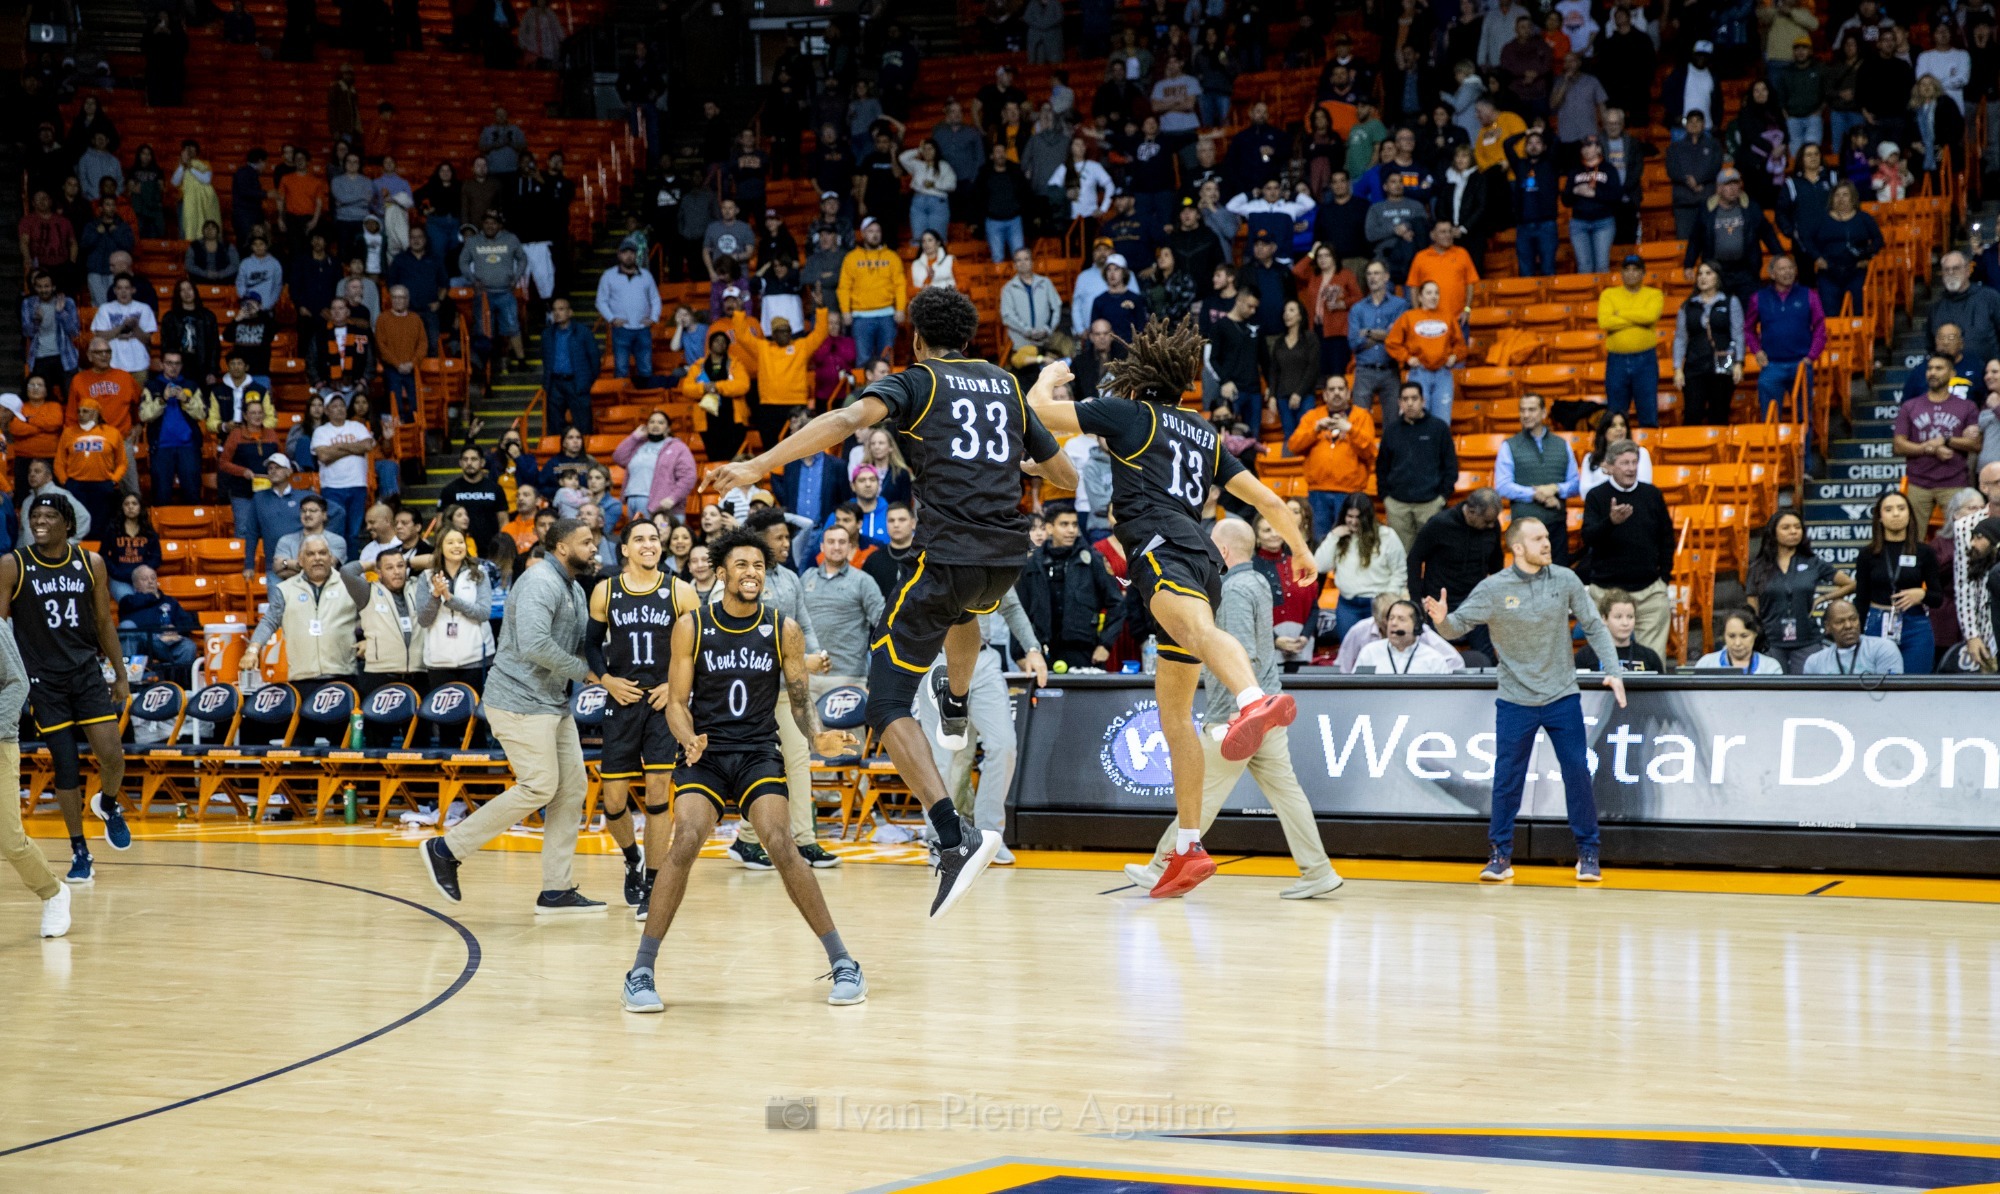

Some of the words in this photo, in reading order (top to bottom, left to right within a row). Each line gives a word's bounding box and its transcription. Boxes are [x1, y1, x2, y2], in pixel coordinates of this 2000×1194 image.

[41, 24, 54, 42] D
[89, 381, 121, 398] UTEP
[945, 374, 1011, 396] THOMAS
[1913, 412, 1931, 430] NM
[1933, 411, 1961, 430] STATE
[950, 398, 1010, 463] 33
[1163, 412, 1215, 451] SULLINGER
[1860, 443, 1893, 459] THE
[1167, 439, 1203, 507] 13
[455, 492, 496, 502] ROGUE
[1819, 485, 1841, 499] OF
[1843, 484, 1882, 498] UTEP
[116, 536, 148, 548] UTEP
[1807, 525, 1852, 540] WE'RE
[1837, 548, 1860, 563] UP
[32, 578, 58, 596] Kent
[59, 575, 86, 594] State
[45, 598, 79, 629] 34
[612, 608, 639, 627] Kent
[641, 604, 671, 627] State
[207, 638, 221, 654] G
[629, 631, 655, 665] 11
[704, 649, 736, 672] Kent
[739, 646, 773, 672] State
[729, 679, 748, 717] 0
[1317, 714, 1747, 785] Westar
[1778, 717, 2000, 789] Don
[1242, 807, 1276, 815] DAKTRO
[1799, 820, 1857, 829] DAKTRONICS
